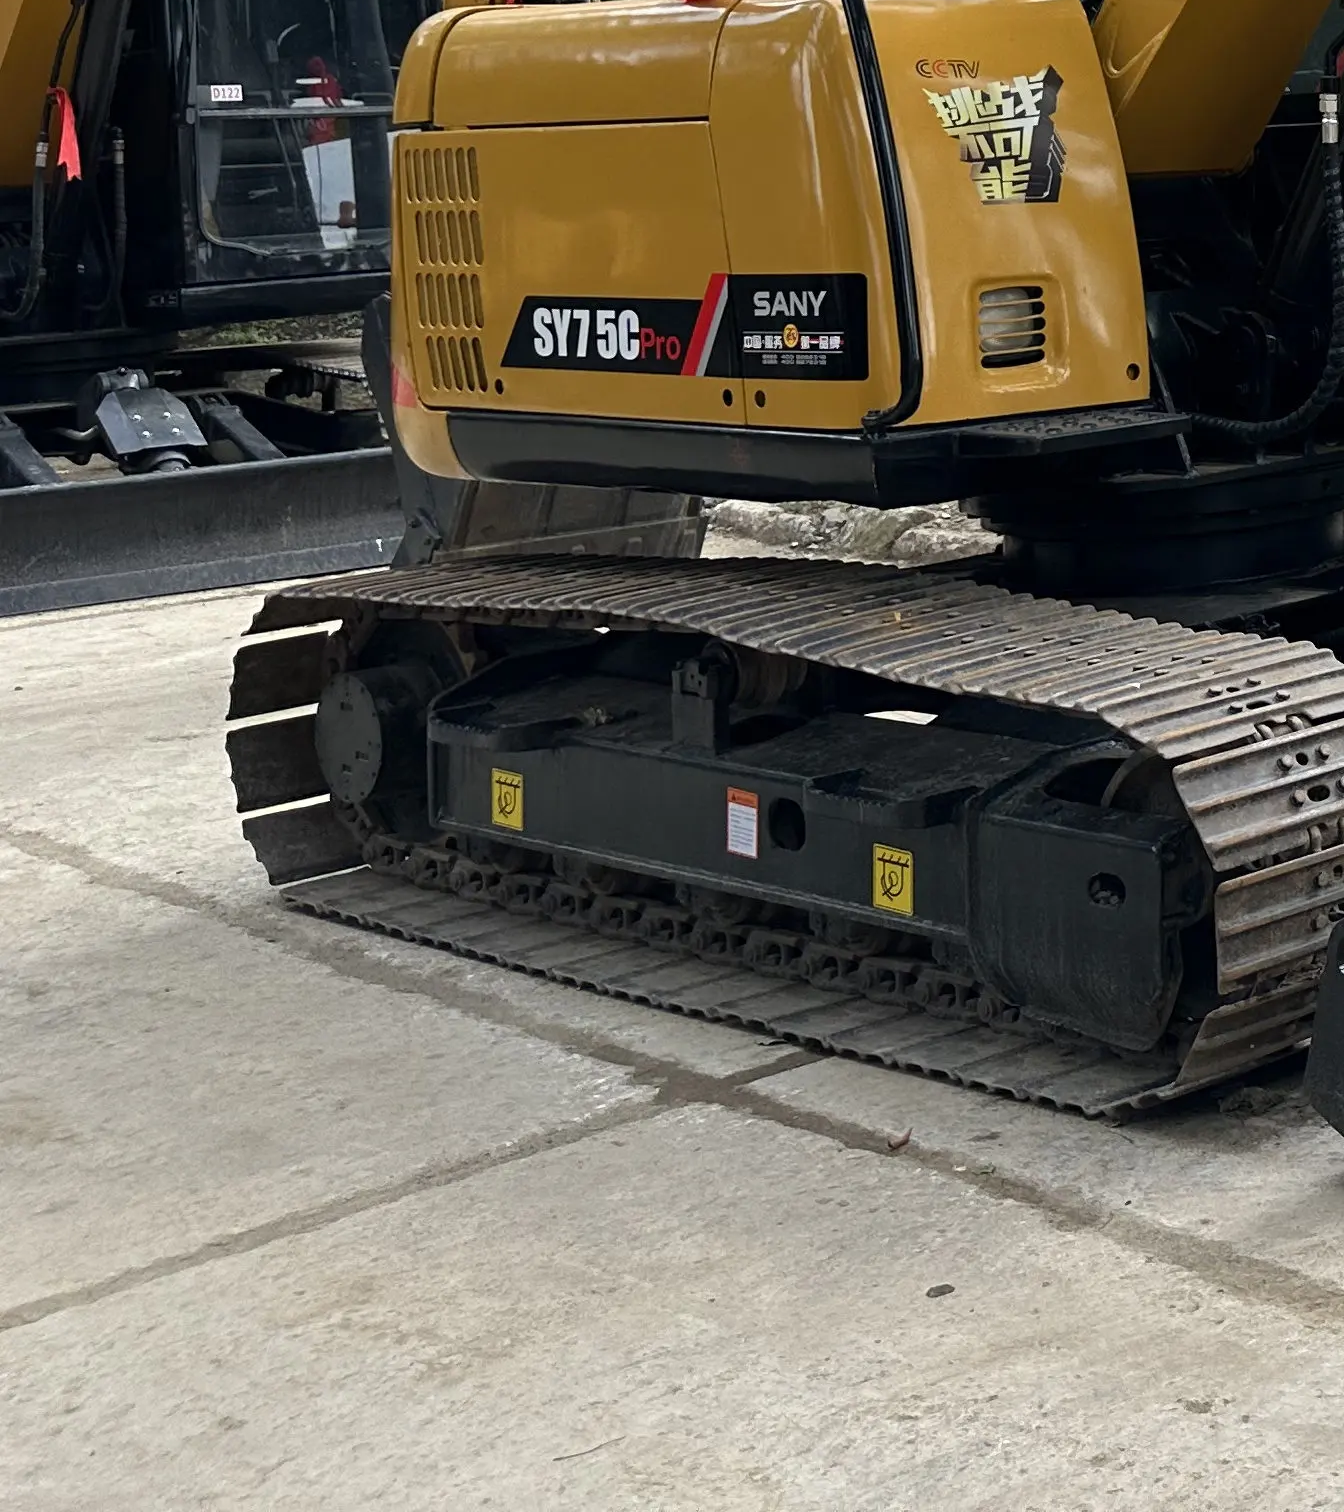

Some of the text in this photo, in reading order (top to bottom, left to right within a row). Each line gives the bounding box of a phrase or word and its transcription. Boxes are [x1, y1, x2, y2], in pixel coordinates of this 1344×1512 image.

[915, 58, 980, 79] CCTV
[212, 87, 241, 99] D122
[921, 64, 1048, 128] 挑战
[943, 115, 1040, 164] 不可
[970, 158, 1032, 204] 能
[753, 291, 827, 316] SANY
[532, 306, 681, 361] SY75C Pro
